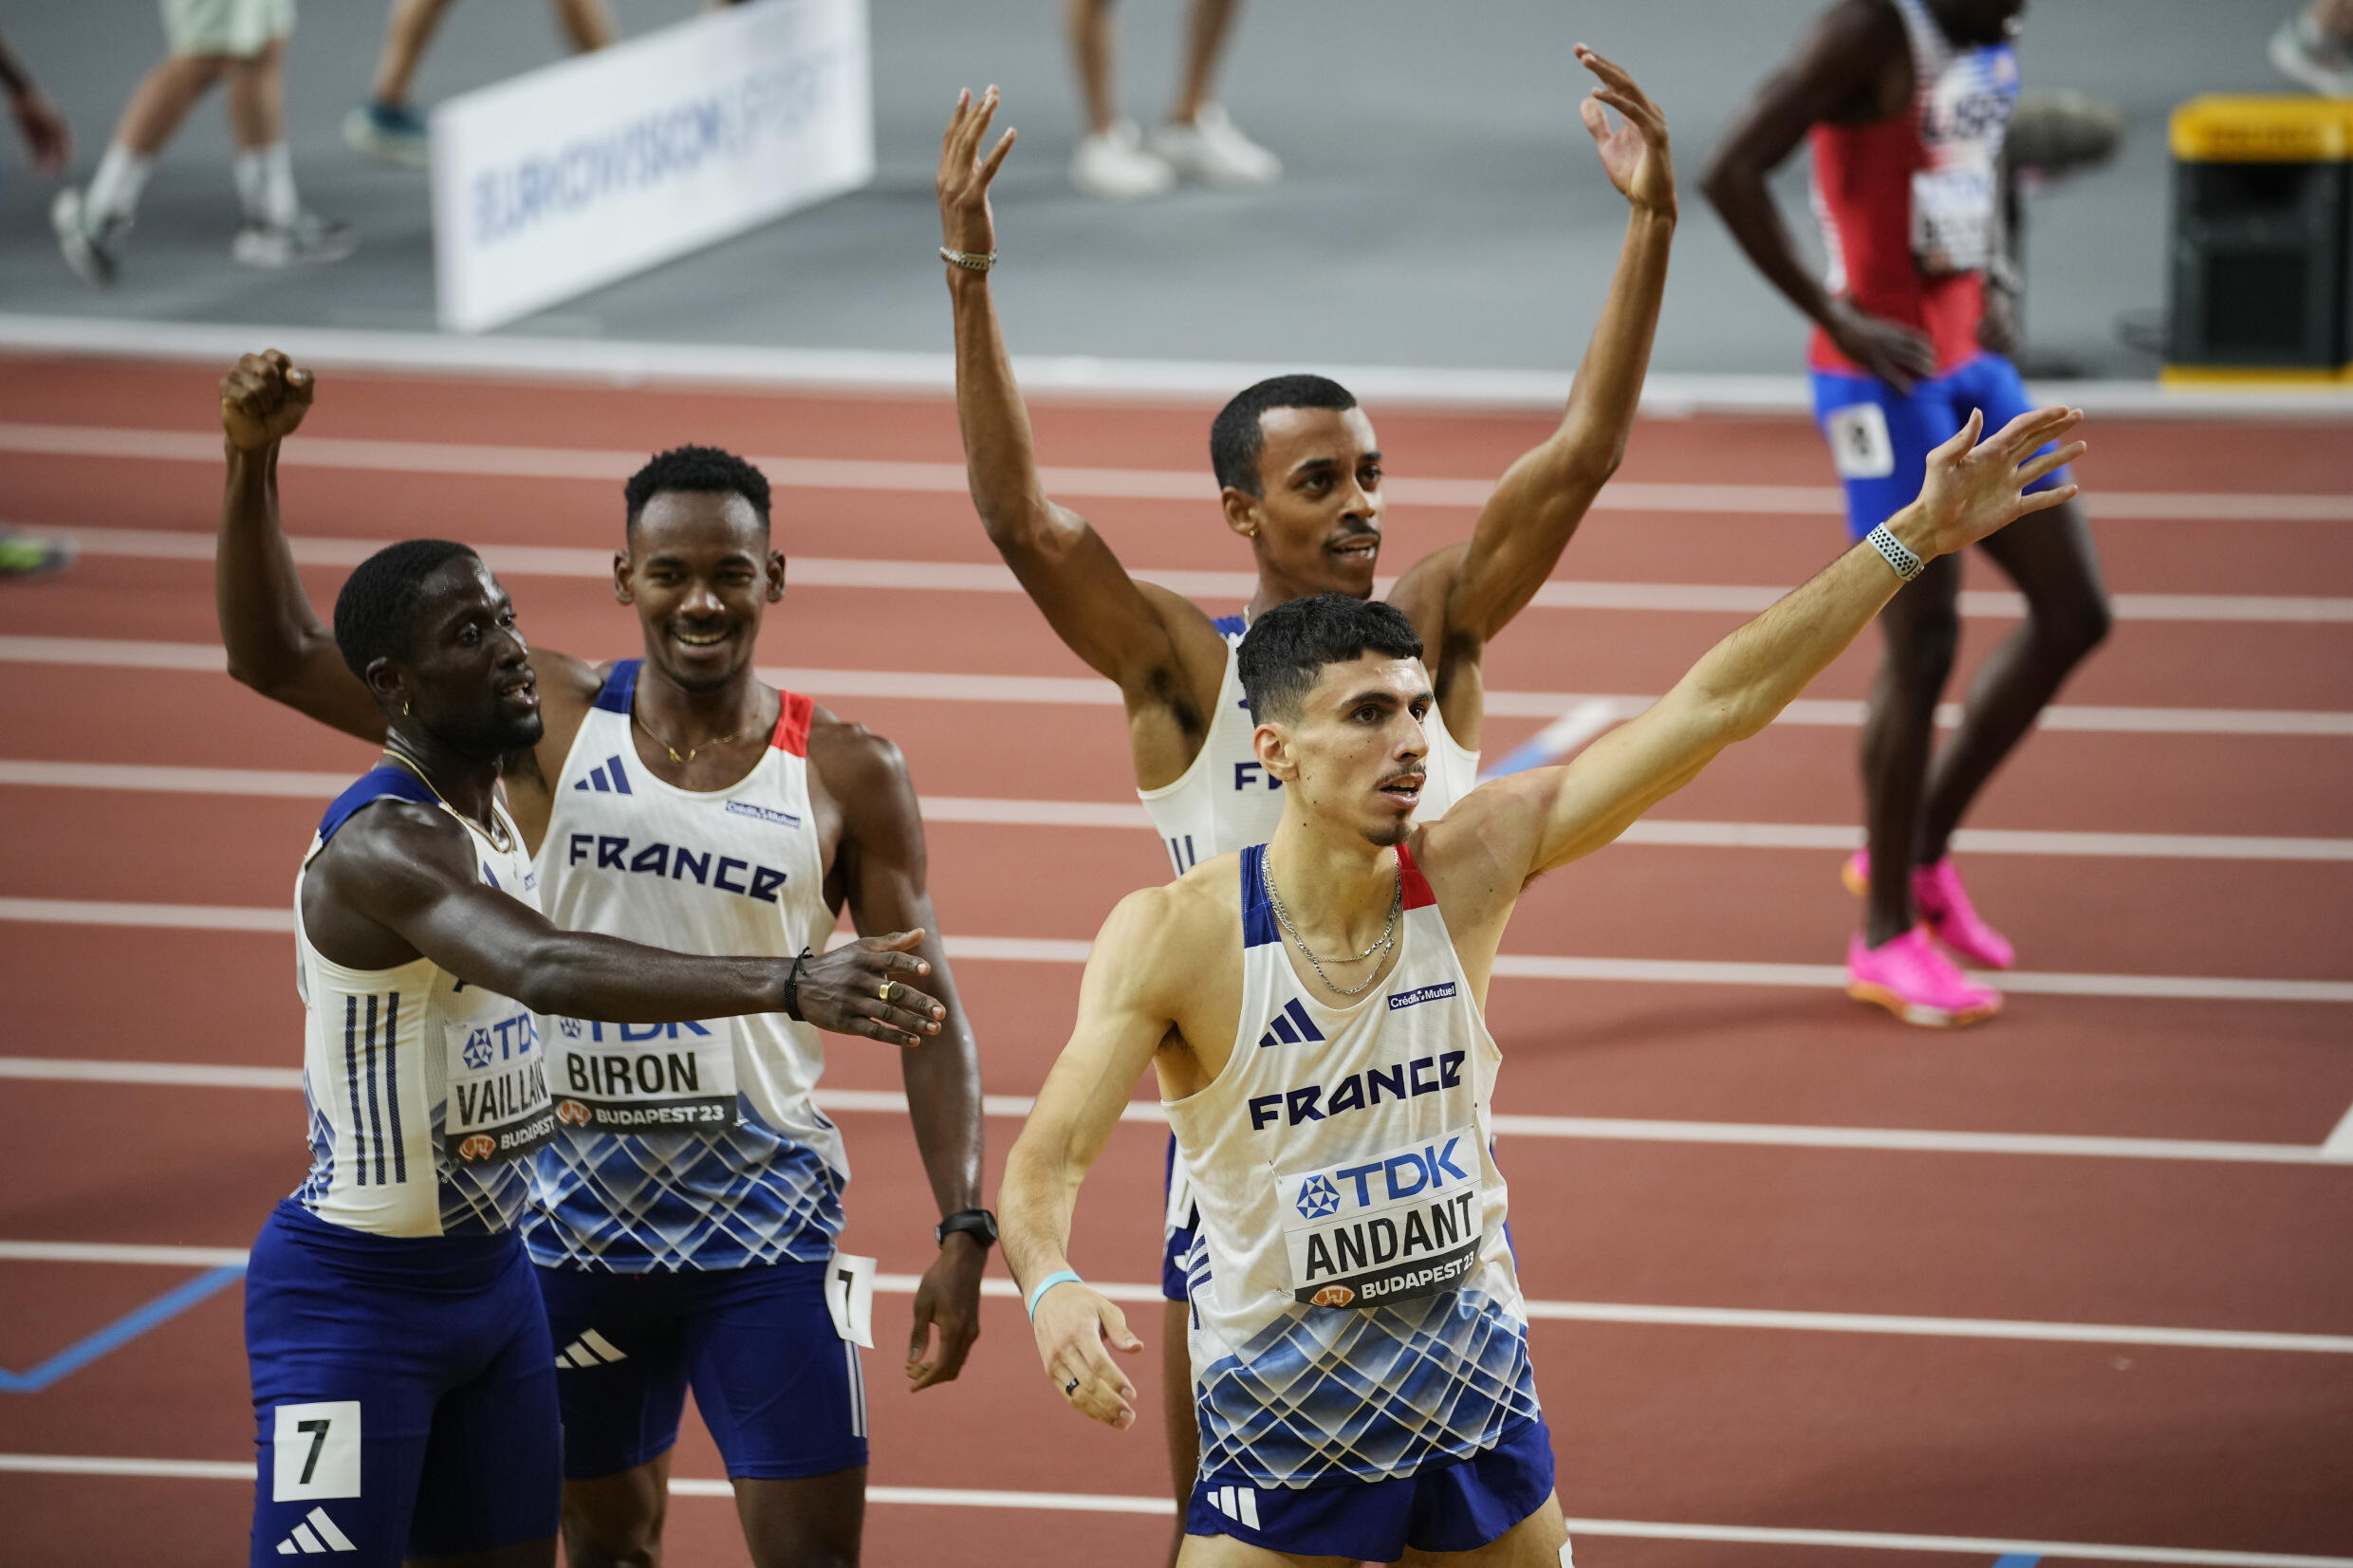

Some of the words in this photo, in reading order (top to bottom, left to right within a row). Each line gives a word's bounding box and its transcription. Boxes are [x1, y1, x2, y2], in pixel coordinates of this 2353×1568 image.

[570, 834, 787, 903] FRANCE
[1424, 985, 1455, 1000] Mutuel
[567, 1051, 699, 1096] BIRON
[1249, 1050, 1465, 1130] FRANCE
[501, 1116, 555, 1150] BUDAPEST
[595, 1106, 697, 1124] BUDAPEST
[699, 1104, 725, 1121] 23
[1336, 1135, 1468, 1208] TDK
[1306, 1190, 1473, 1281] ANDANT
[1362, 1258, 1463, 1300] BUDAPEST
[1463, 1251, 1474, 1271] 23
[297, 1419, 331, 1485] 7
